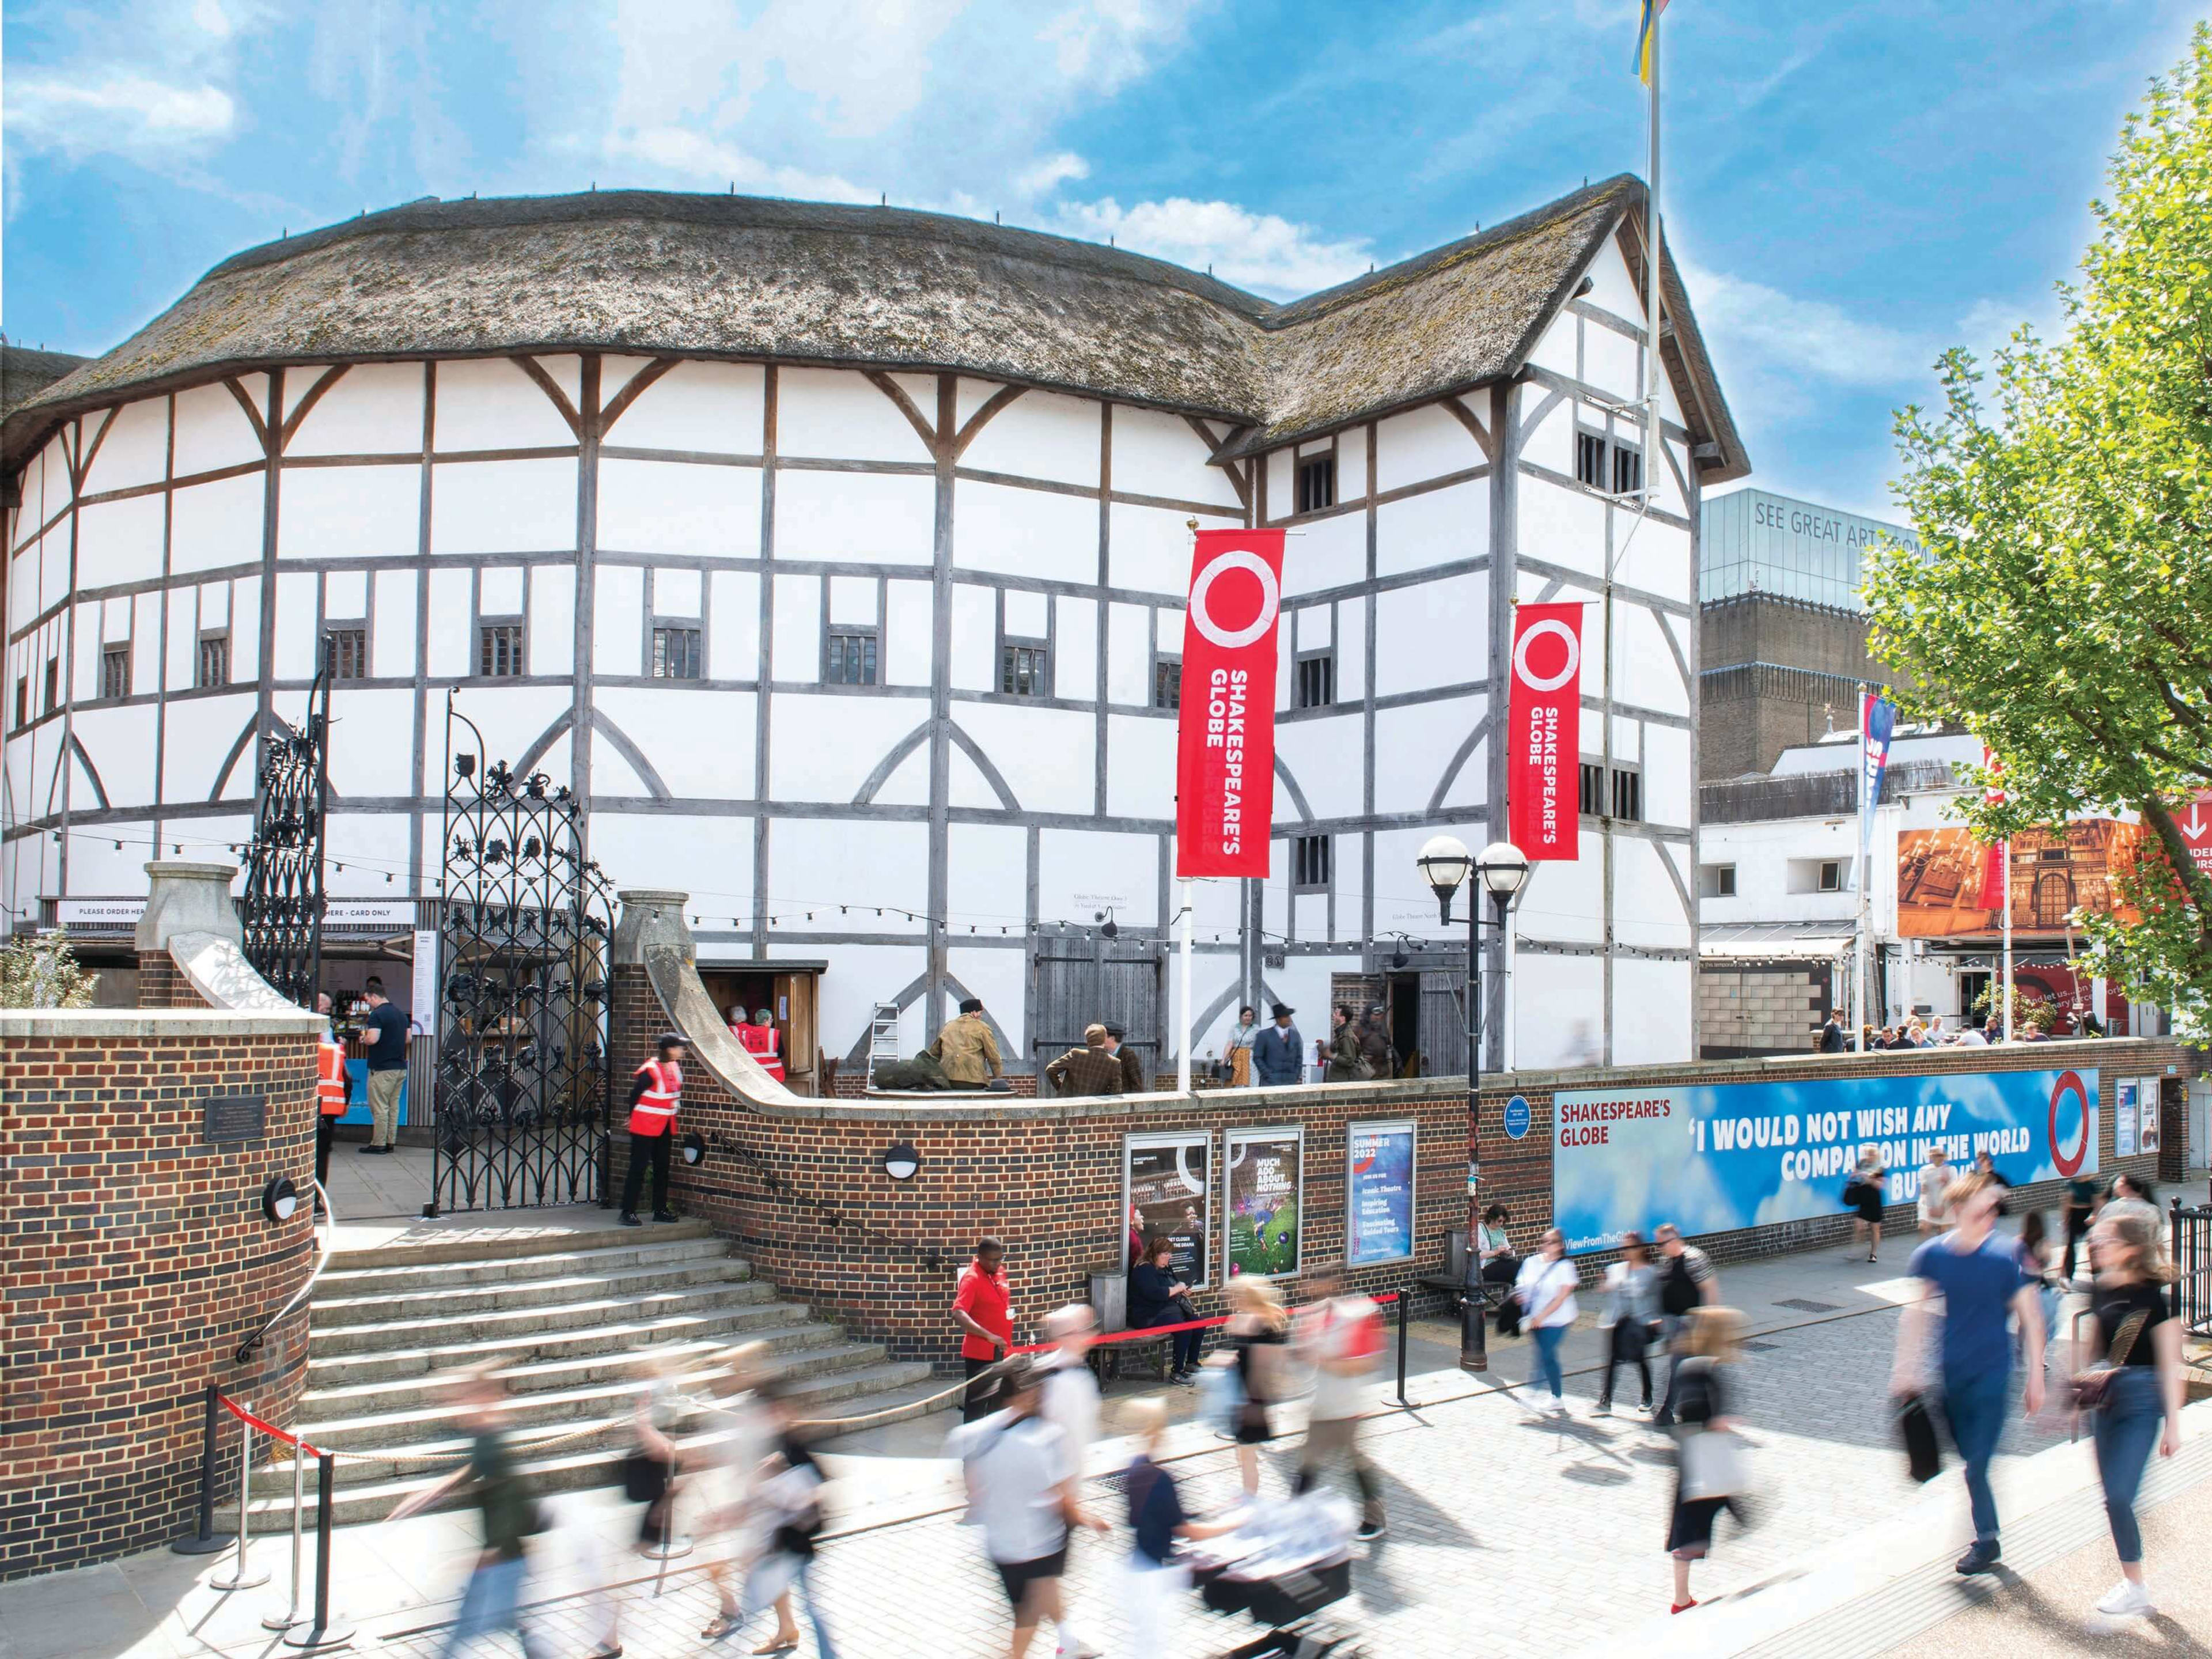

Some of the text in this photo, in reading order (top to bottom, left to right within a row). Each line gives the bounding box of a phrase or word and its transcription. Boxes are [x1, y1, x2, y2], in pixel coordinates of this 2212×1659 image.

[1756, 502, 1784, 529] SEE
[1790, 511, 1842, 543] GREAT
[1846, 525, 1876, 547] ART
[1207, 669, 1228, 748] GLOBE
[1529, 707, 1543, 765] GLOBE
[1222, 669, 1248, 855] SHAKESPEARE'S
[1543, 707, 1558, 844] SHAKESPEARE'S
[1560, 1099, 1671, 1123] SHAKESPEARE'S
[1560, 1126, 1609, 1147] GLOBE
[1712, 1114, 1800, 1150] WOULD
[1806, 1111, 1851, 1143] NOT
[1856, 1106, 1908, 1138] WISH
[1912, 1104, 1952, 1134] ANY
[1354, 1138, 1390, 1149] SUMMER
[1354, 1148, 1376, 1158] 2022
[1781, 1139, 1907, 1181] COMPAON
[1911, 1137, 1930, 1165] IN
[1973, 1126, 2030, 1158] WORLD
[1257, 1158, 1280, 1167] MUCH
[1257, 1167, 1275, 1176] ADO
[1256, 1181, 1292, 1192] NOTHING
[1257, 1174, 1285, 1184] ABOUT
[1891, 1169, 1921, 1201] BU
